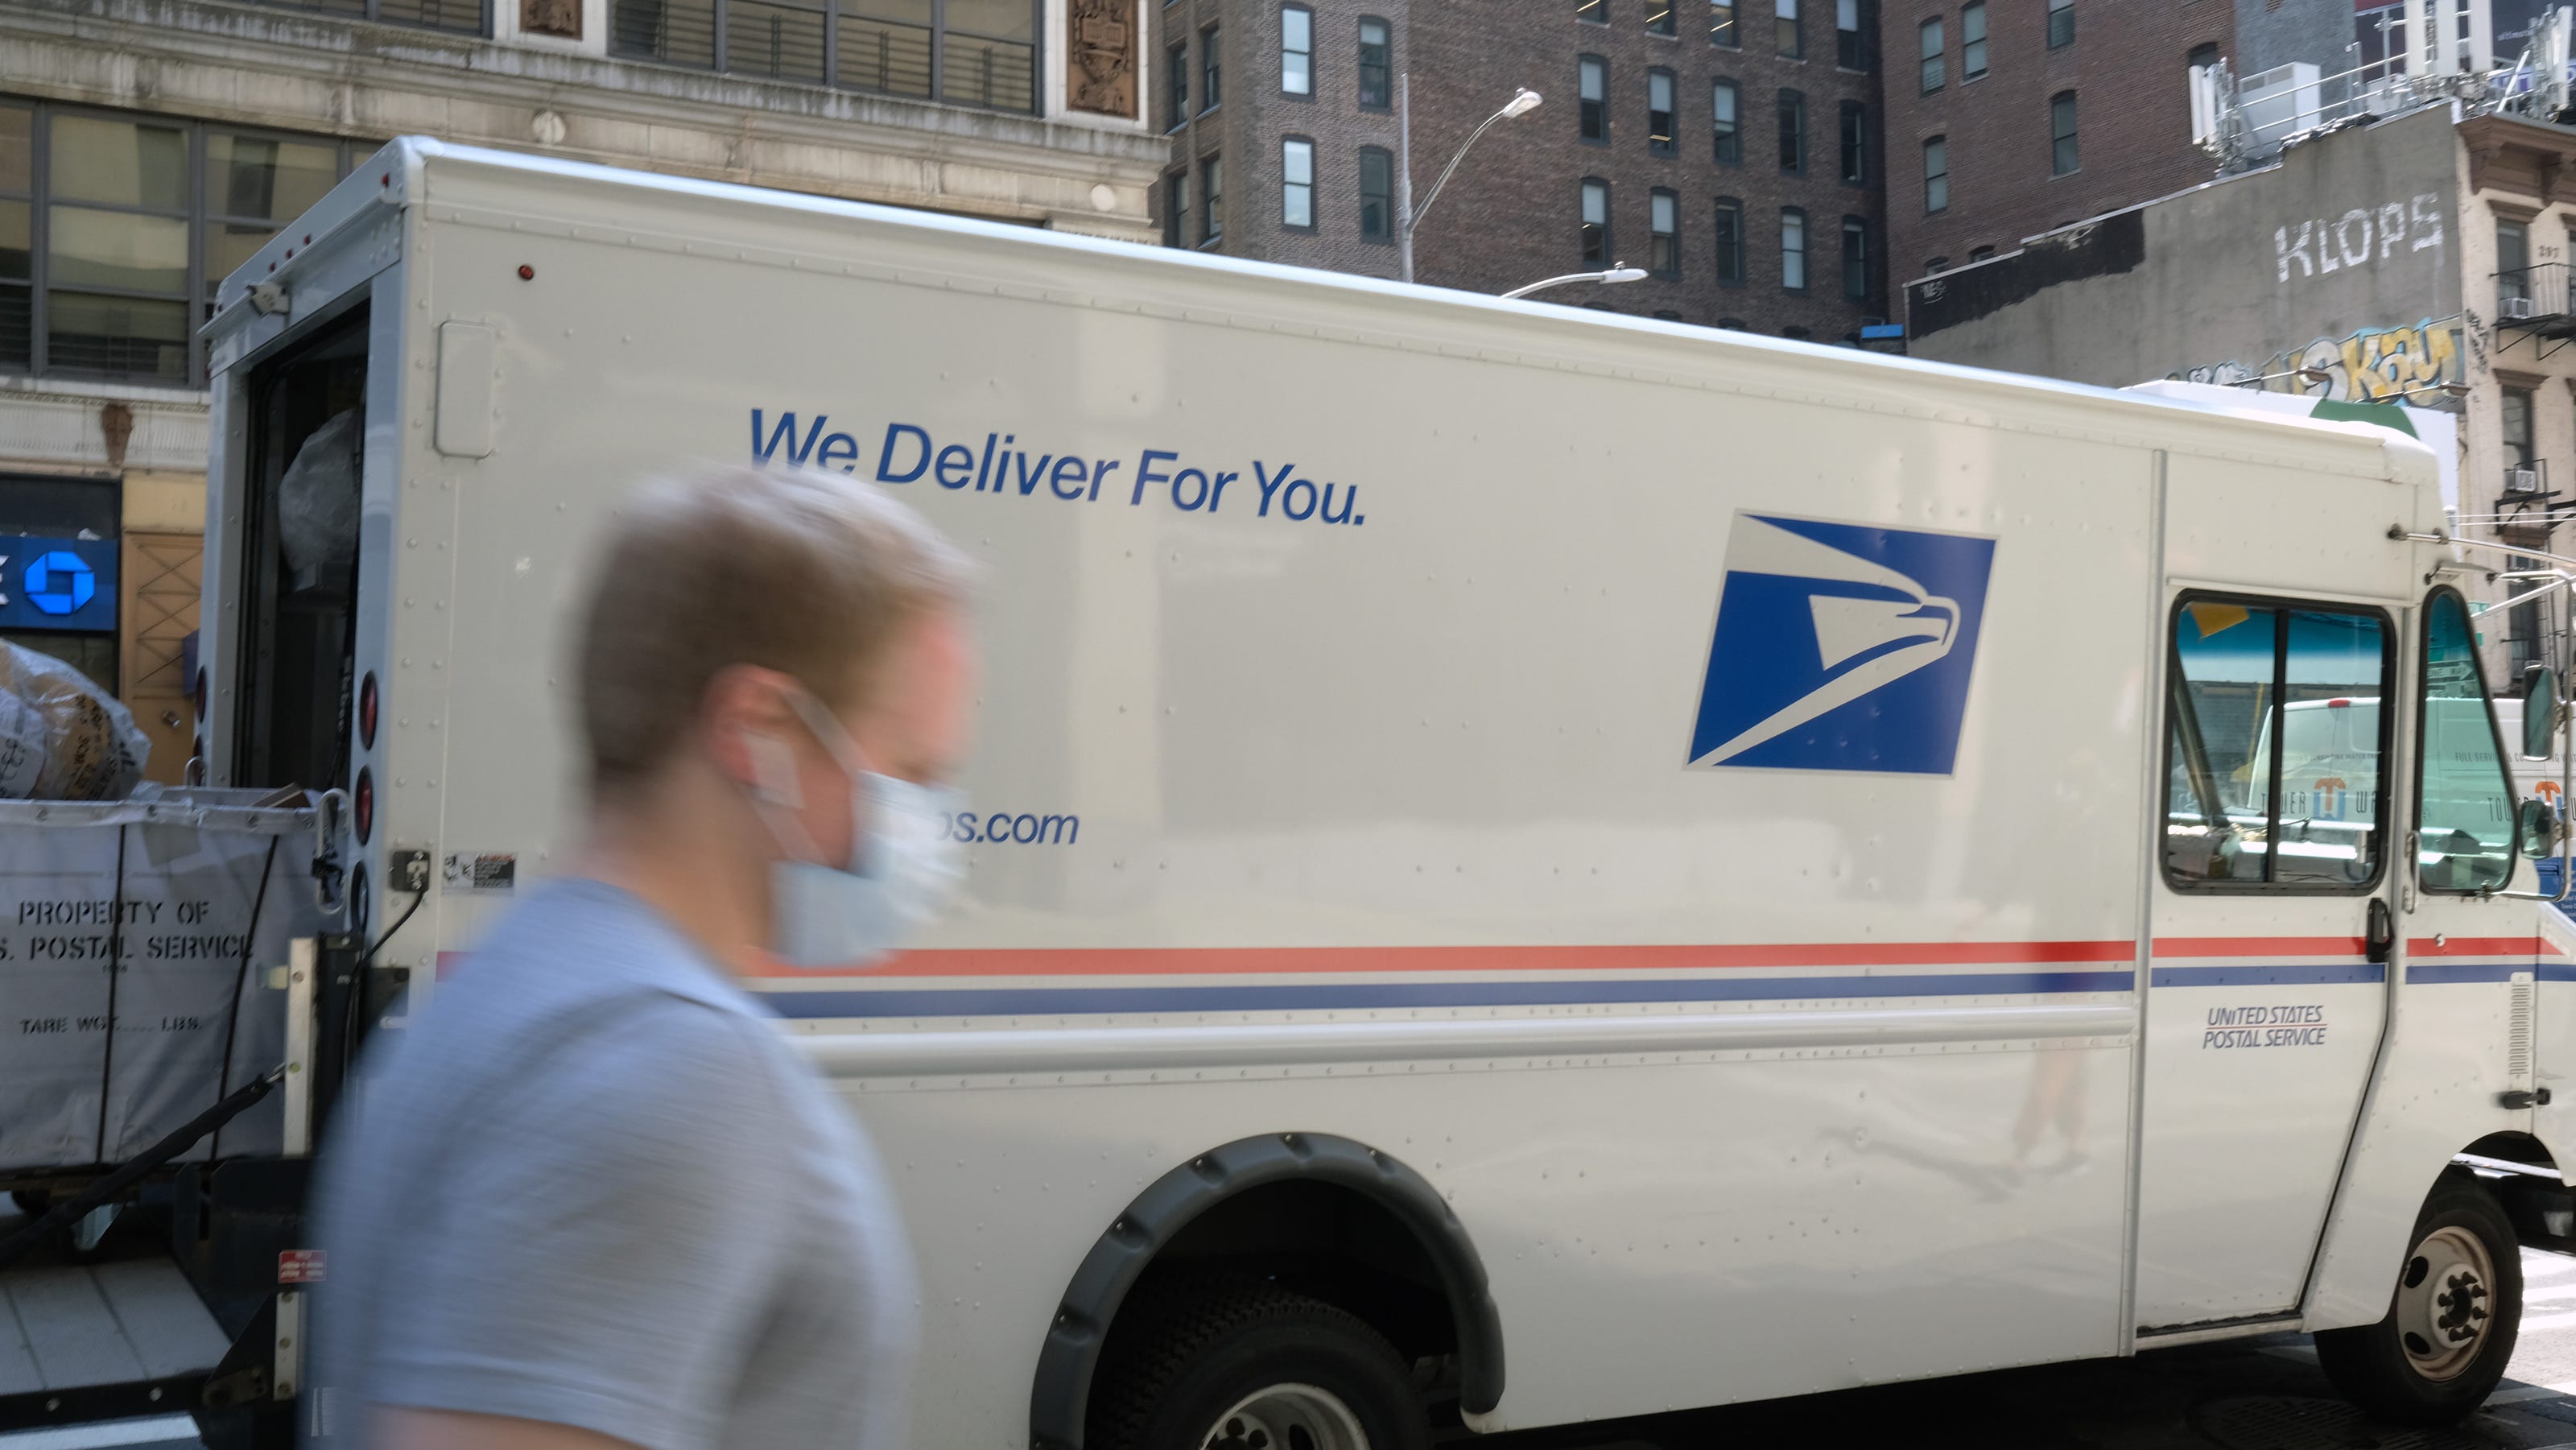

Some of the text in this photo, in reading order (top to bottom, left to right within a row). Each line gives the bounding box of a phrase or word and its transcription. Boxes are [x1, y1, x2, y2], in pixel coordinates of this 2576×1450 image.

[2274, 192, 2444, 283] KLOPS
[750, 407, 1366, 526] We Deliver For You.
[2455, 753, 2471, 762] FULL
[2474, 753, 2499, 762] SERVI
[2261, 791, 2306, 814] TWER
[2487, 796, 2529, 822] TOW
[19, 900, 209, 924] PROPERTY OF
[29, 936, 134, 960] POSTAL
[20, 1017, 69, 1034] TARE
[2207, 1006, 2324, 1026] UNITED STATES
[2202, 1027, 2327, 1050] POSTAL SERVICE
